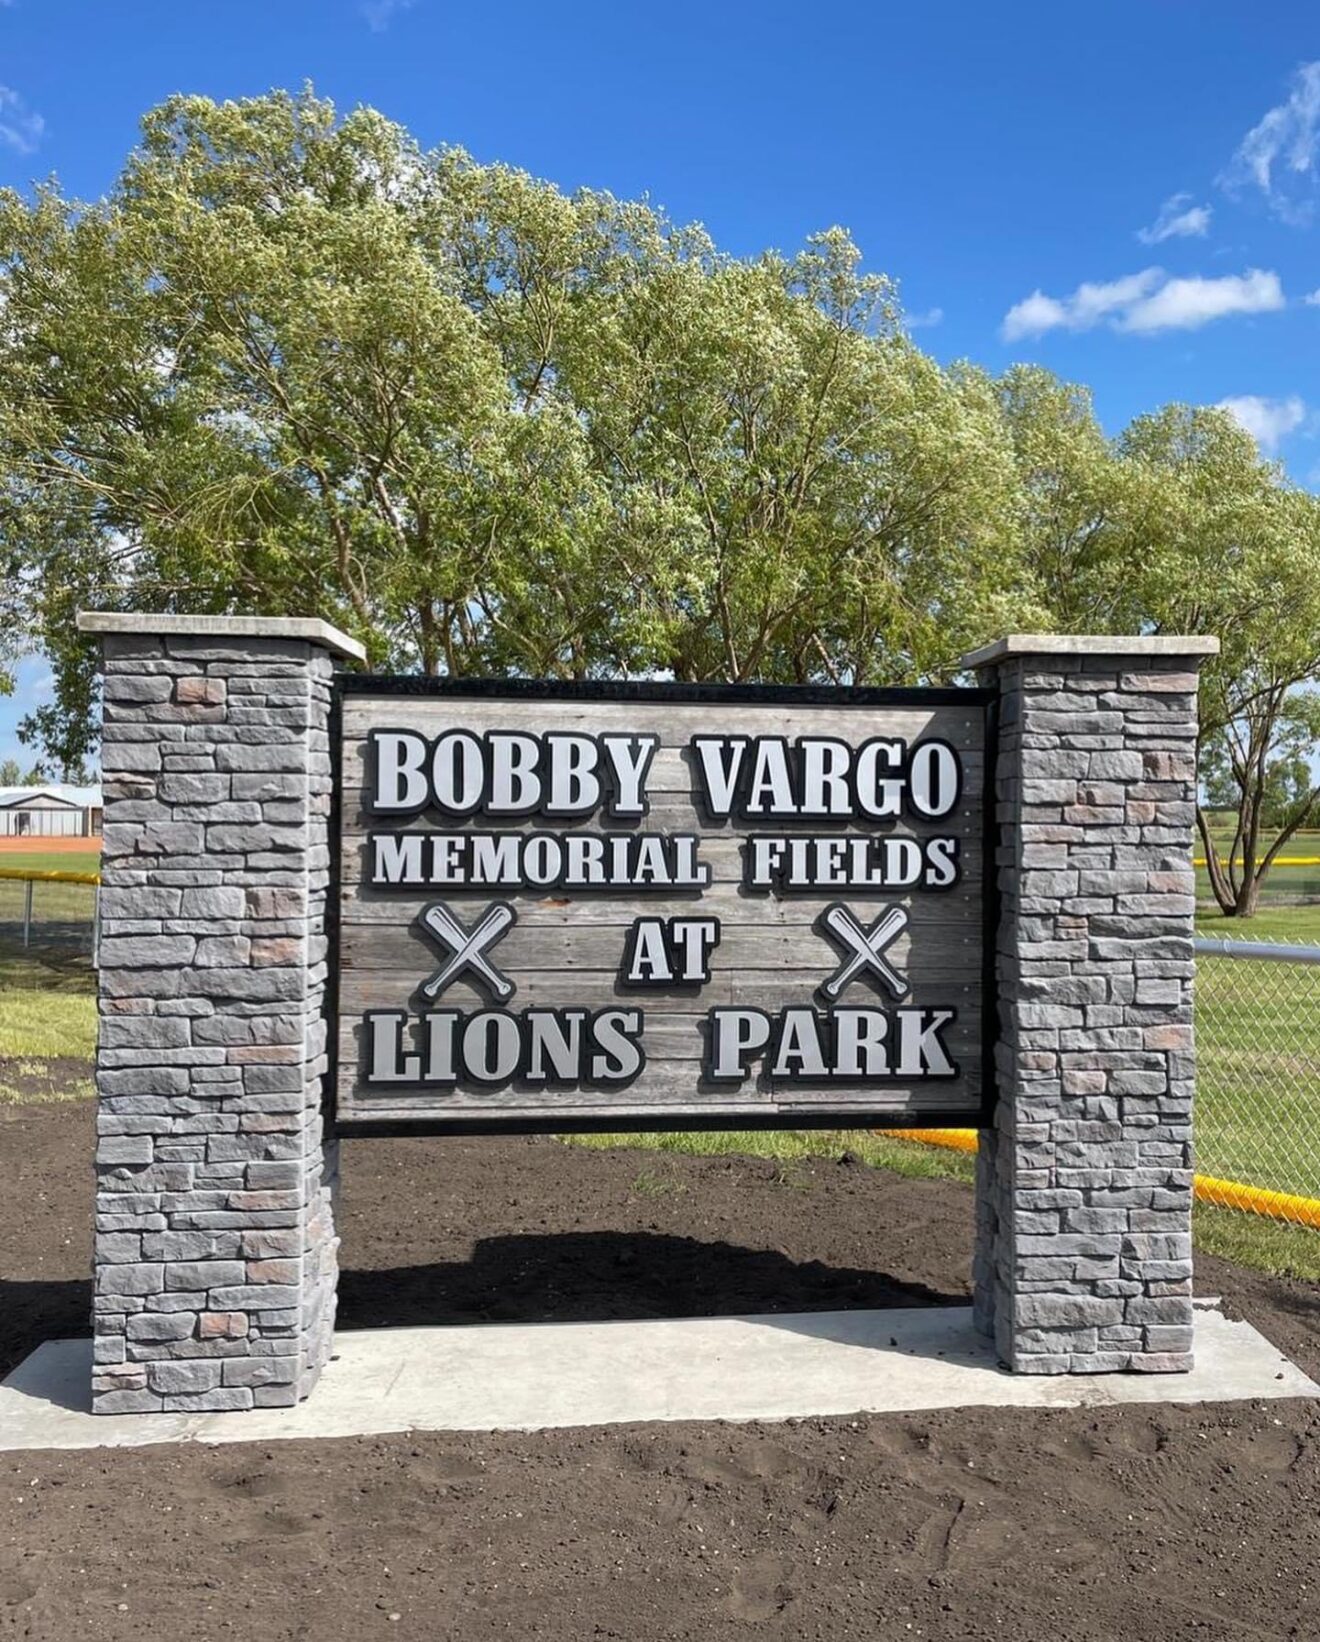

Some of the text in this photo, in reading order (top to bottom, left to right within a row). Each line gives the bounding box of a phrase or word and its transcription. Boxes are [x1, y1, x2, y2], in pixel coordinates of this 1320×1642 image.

[372, 731, 958, 817] BOBBY VARGO
[371, 834, 958, 887] MEMORIAL FIELDS
[627, 920, 716, 982] AT
[369, 1009, 957, 1083] LIONS PARK
